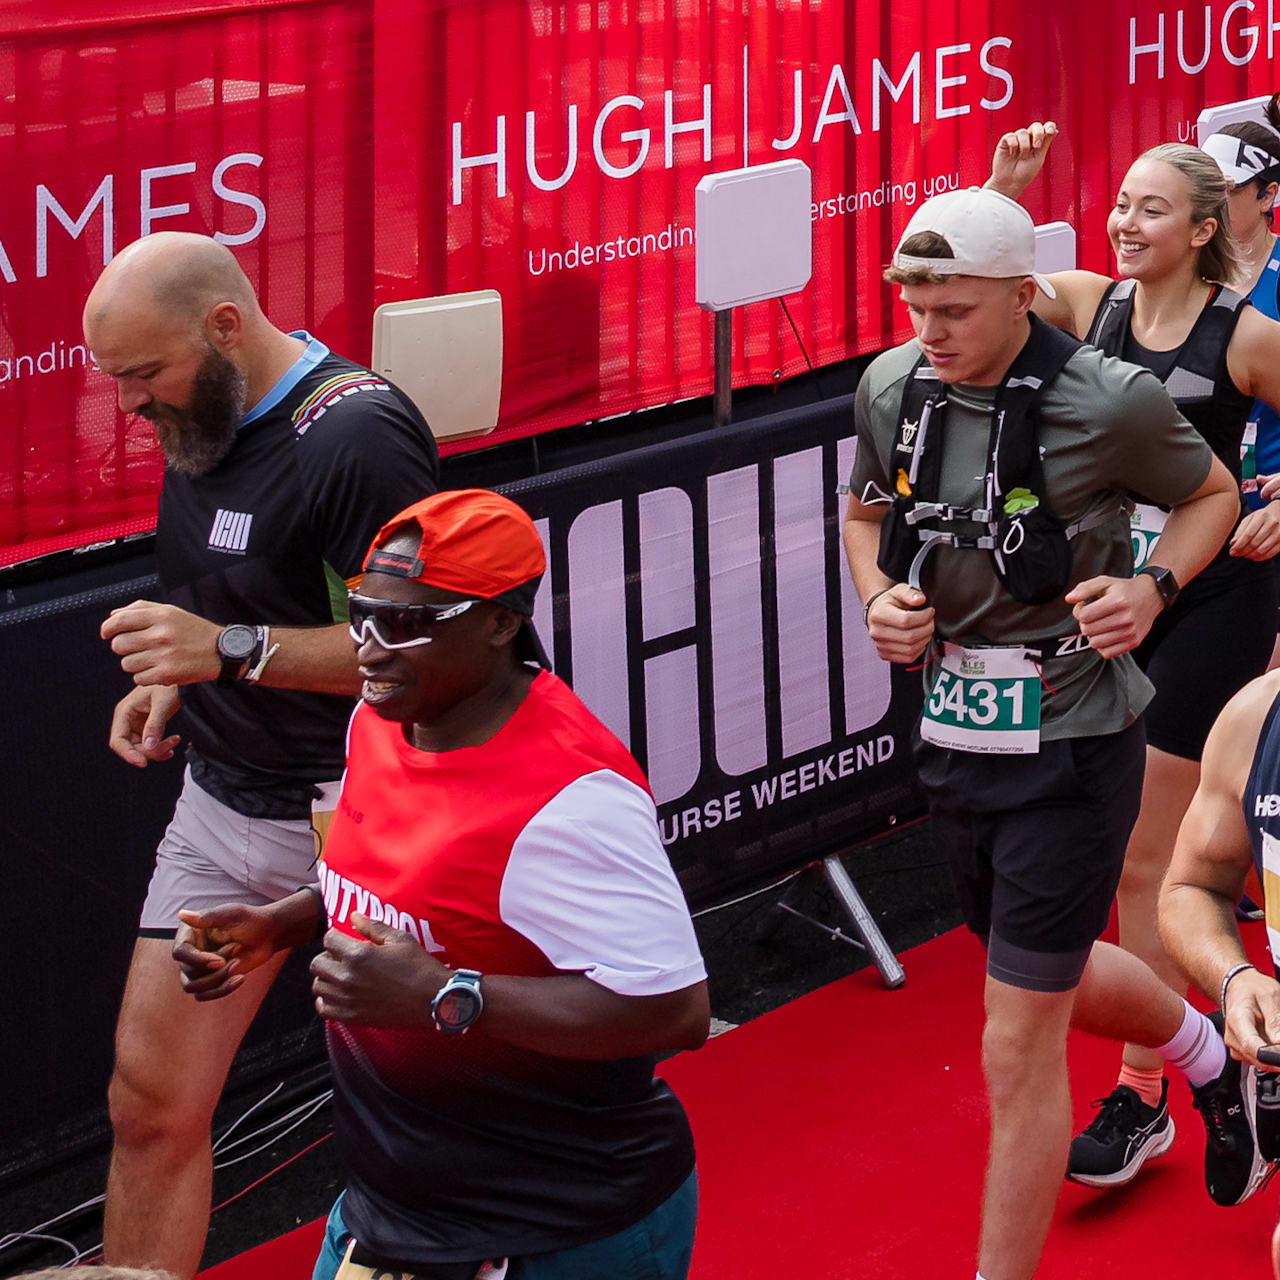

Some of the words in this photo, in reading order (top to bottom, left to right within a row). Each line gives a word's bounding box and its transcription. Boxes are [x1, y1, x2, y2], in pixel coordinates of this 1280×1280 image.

[451, 84, 714, 206] HUGH
[772, 35, 1015, 151] JAMES
[527, 220, 697, 278] Understandin
[923, 169, 961, 206] you
[928, 670, 1025, 726] 5431
[751, 734, 896, 811] WEEKEND
